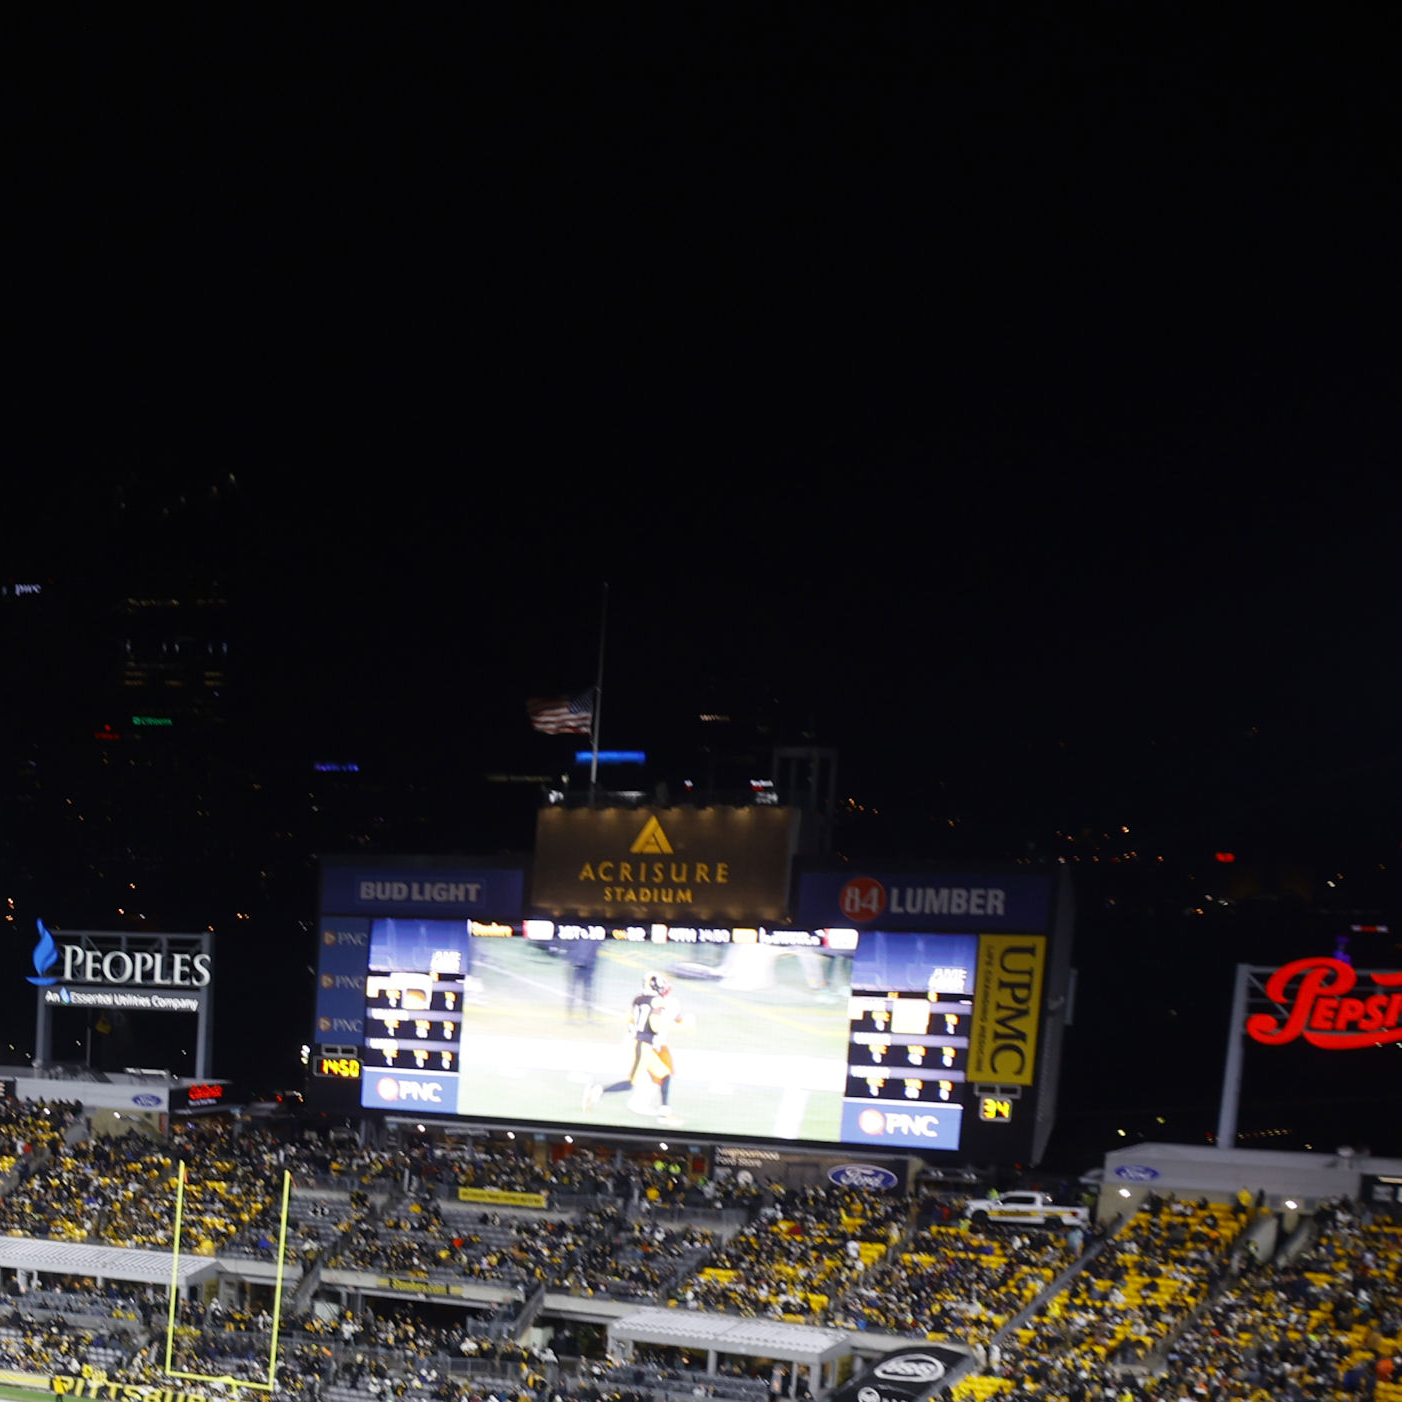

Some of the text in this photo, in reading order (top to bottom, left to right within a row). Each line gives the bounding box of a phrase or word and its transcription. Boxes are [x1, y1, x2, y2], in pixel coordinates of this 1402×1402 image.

[578, 861, 730, 884] ACRISURE
[360, 881, 481, 902] BUD LIGHT
[603, 886, 693, 904] STADIUM
[844, 886, 1006, 916] 84 LUMBER
[337, 931, 368, 947] PNC
[64, 945, 212, 987] PEOPLES
[335, 974, 365, 990] PNC
[45, 990, 198, 1012] An Essential Utilities Company
[989, 943, 1037, 1077] UPMC
[332, 1017, 363, 1033] PNC
[399, 1079, 442, 1102] PNC
[983, 1097, 1010, 1119] 34
[885, 1113, 939, 1137] PNC
[839, 1165, 886, 1189] Ford
